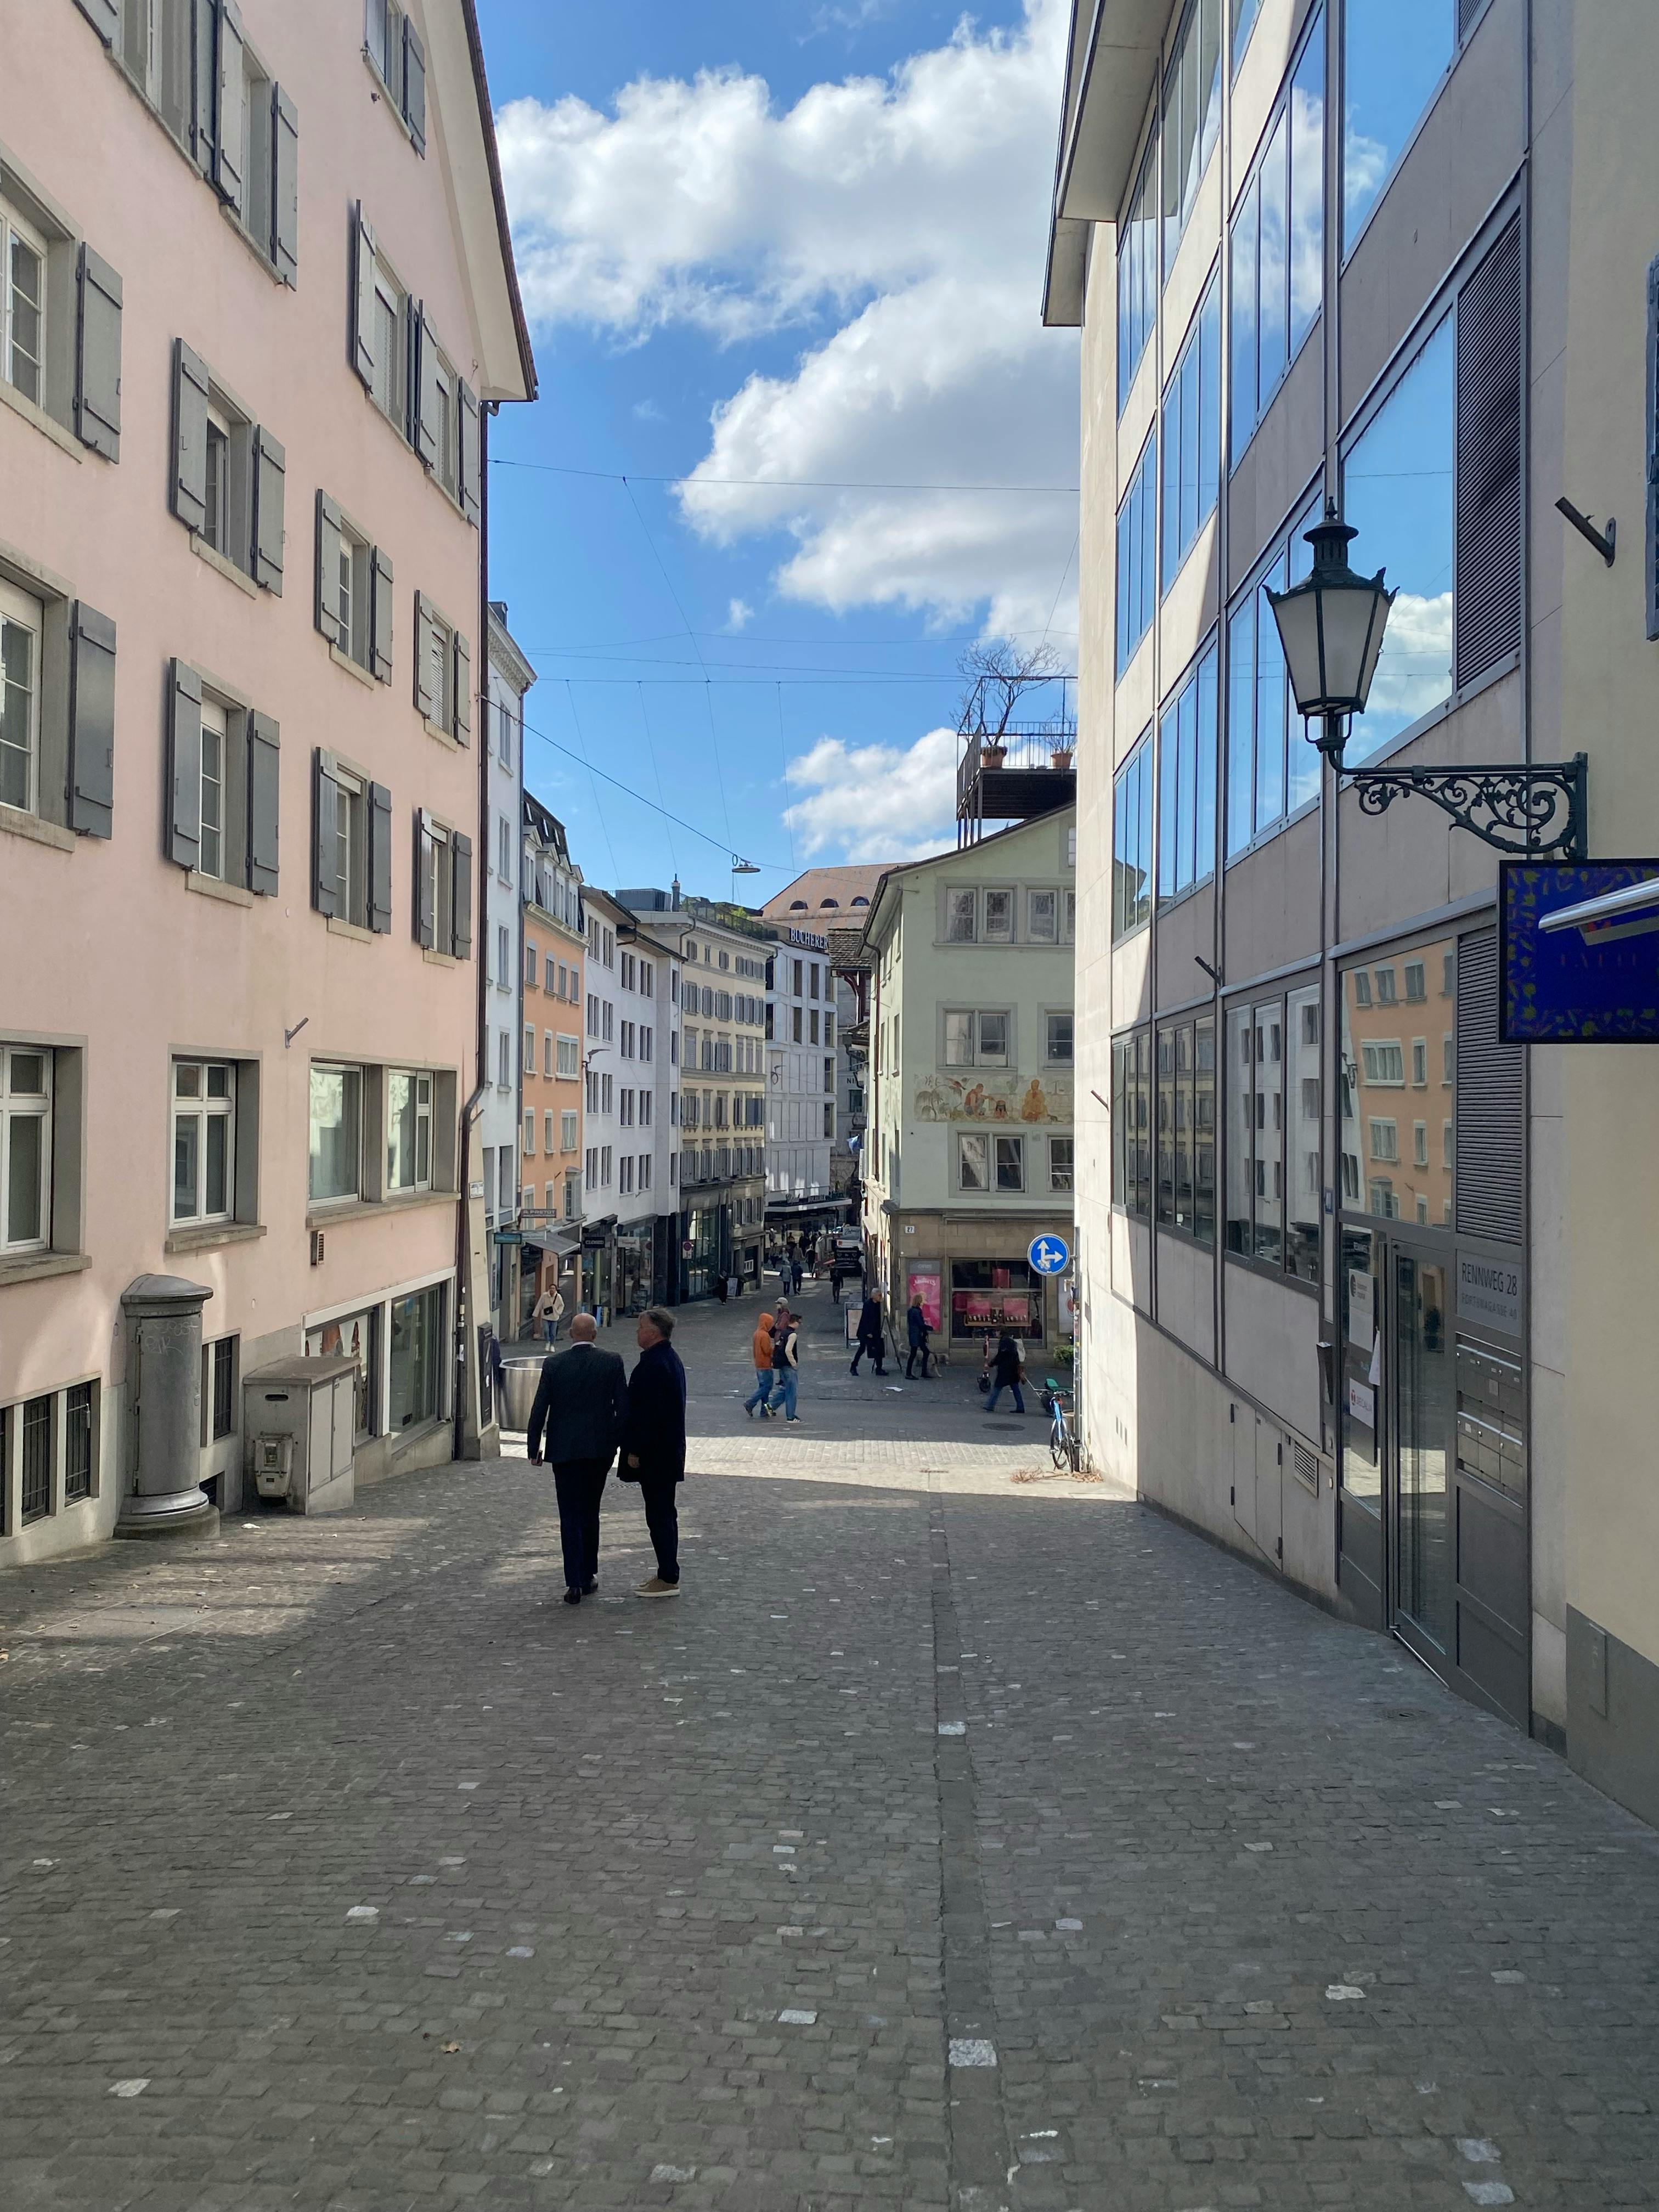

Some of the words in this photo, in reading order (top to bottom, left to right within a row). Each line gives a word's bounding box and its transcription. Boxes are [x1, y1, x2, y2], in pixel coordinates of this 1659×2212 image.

[791, 928, 828, 950] BUCHERER
[1462, 1263, 1504, 1293] RENNWEG
[1507, 1274, 1517, 1296] 28
